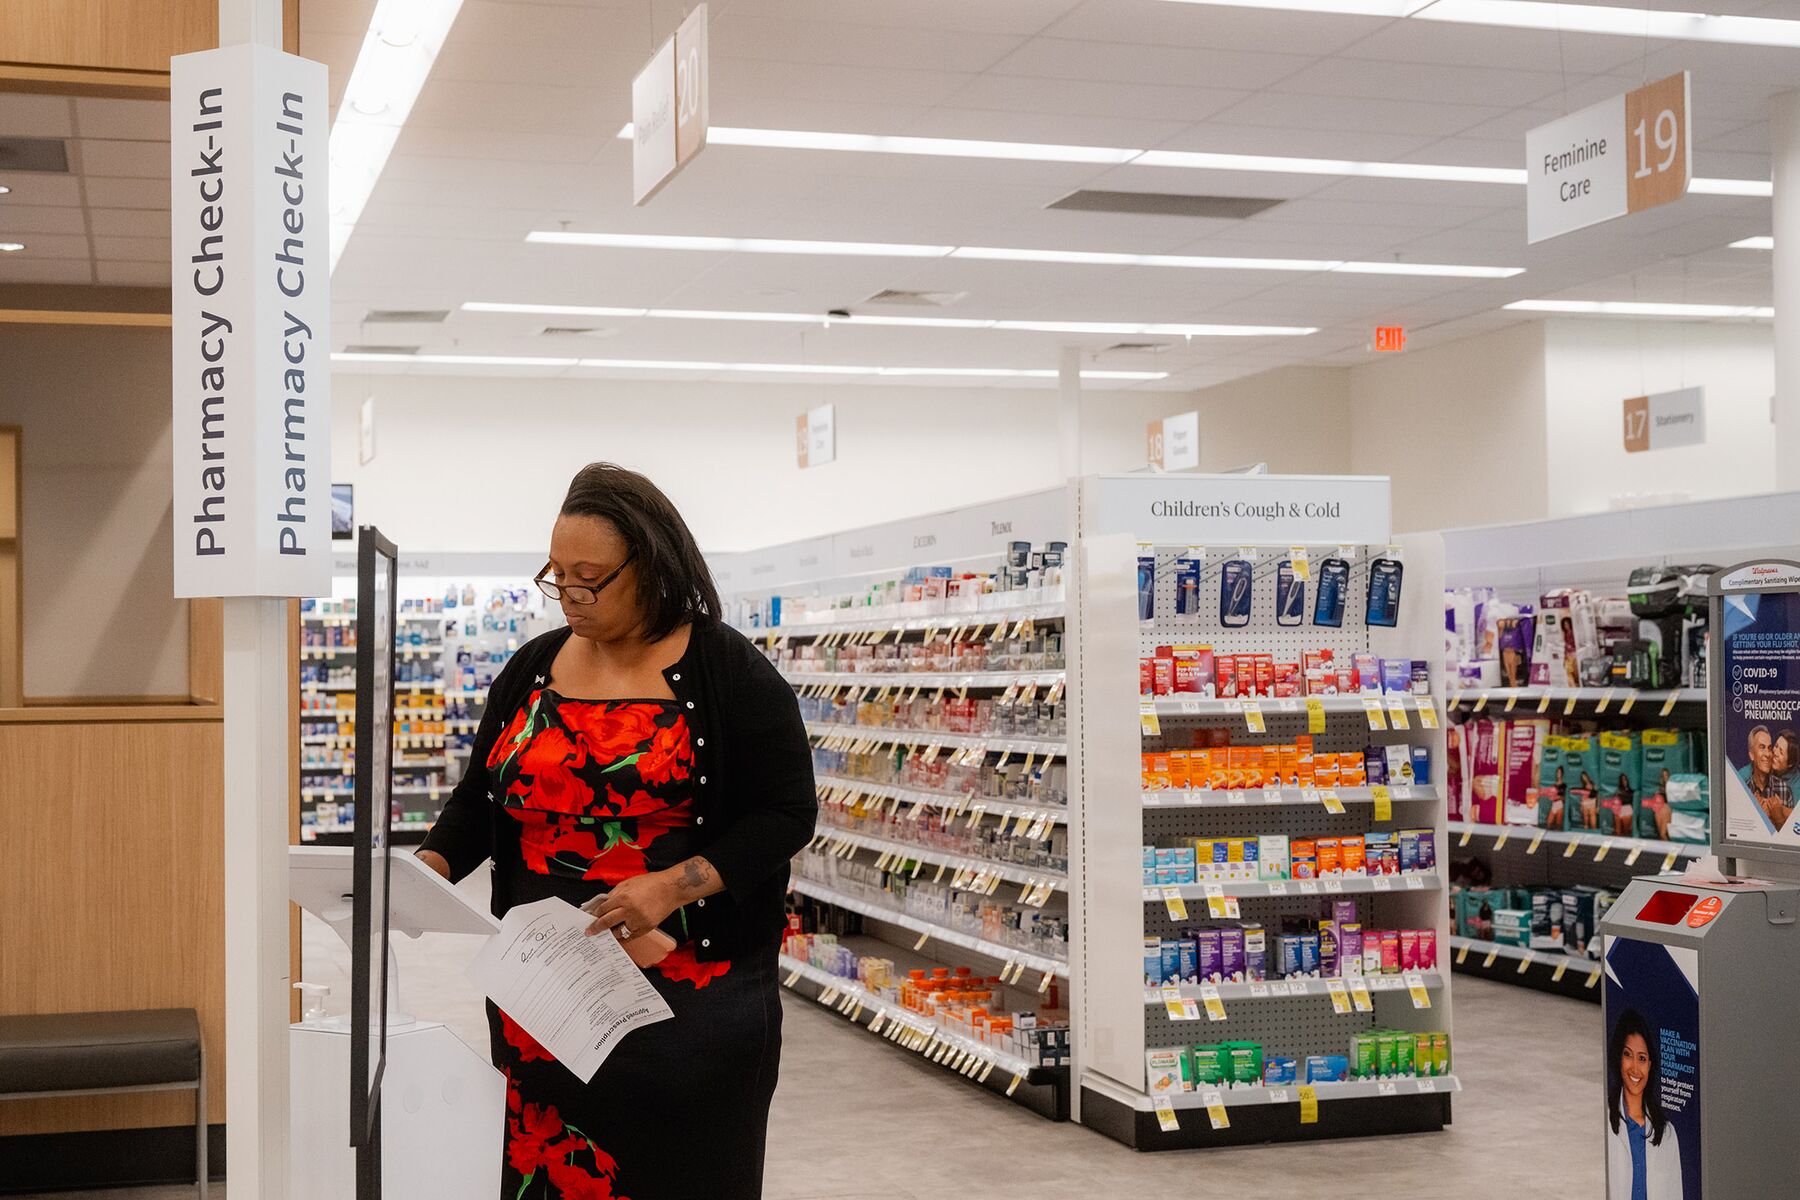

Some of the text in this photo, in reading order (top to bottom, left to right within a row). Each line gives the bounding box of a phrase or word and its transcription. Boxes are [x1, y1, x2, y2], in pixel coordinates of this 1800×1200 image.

[678, 47, 698, 128] 20
[1634, 109, 1678, 179] 19
[1544, 138, 1607, 175] Feminine
[1560, 178, 1591, 202] Care
[191, 87, 233, 556] Pharmacy Check-In
[274, 92, 312, 556] Pharmacy Check-In
[1376, 327, 1402, 351] EXIT
[1625, 410, 1695, 441] 17 Stationery
[1149, 432, 1162, 461] 18
[1150, 501, 1341, 522] Children's Cough & Cold
[1752, 567, 1778, 575] Walgreens
[1729, 578, 1763, 587] Complimentary
[1764, 576, 1787, 586] Sanitizing
[1756, 640, 1772, 648] YOUR
[1772, 640, 1782, 648] FLU
[1743, 667, 1778, 678] COVID-19
[1743, 684, 1759, 694] RSV
[1744, 710, 1793, 721] PNEUMONIA
[625, 1007, 650, 1020] Approved
[594, 1016, 628, 1051] Prescription
[1660, 1028, 1675, 1038] MAKE
[1660, 1036, 1697, 1051] VACCINATION
[1660, 1044, 1690, 1057] PLAN WITH
[1660, 1052, 1676, 1061] YOUR
[1660, 1059, 1695, 1074] PHARMACIST
[1661, 1067, 1679, 1078] TODAY
[1666, 1078, 1677, 1087] help
[1677, 1081, 1694, 1090] protect
[1661, 1085, 1692, 1098] yourself from
[1661, 1094, 1687, 1107] respiratory
